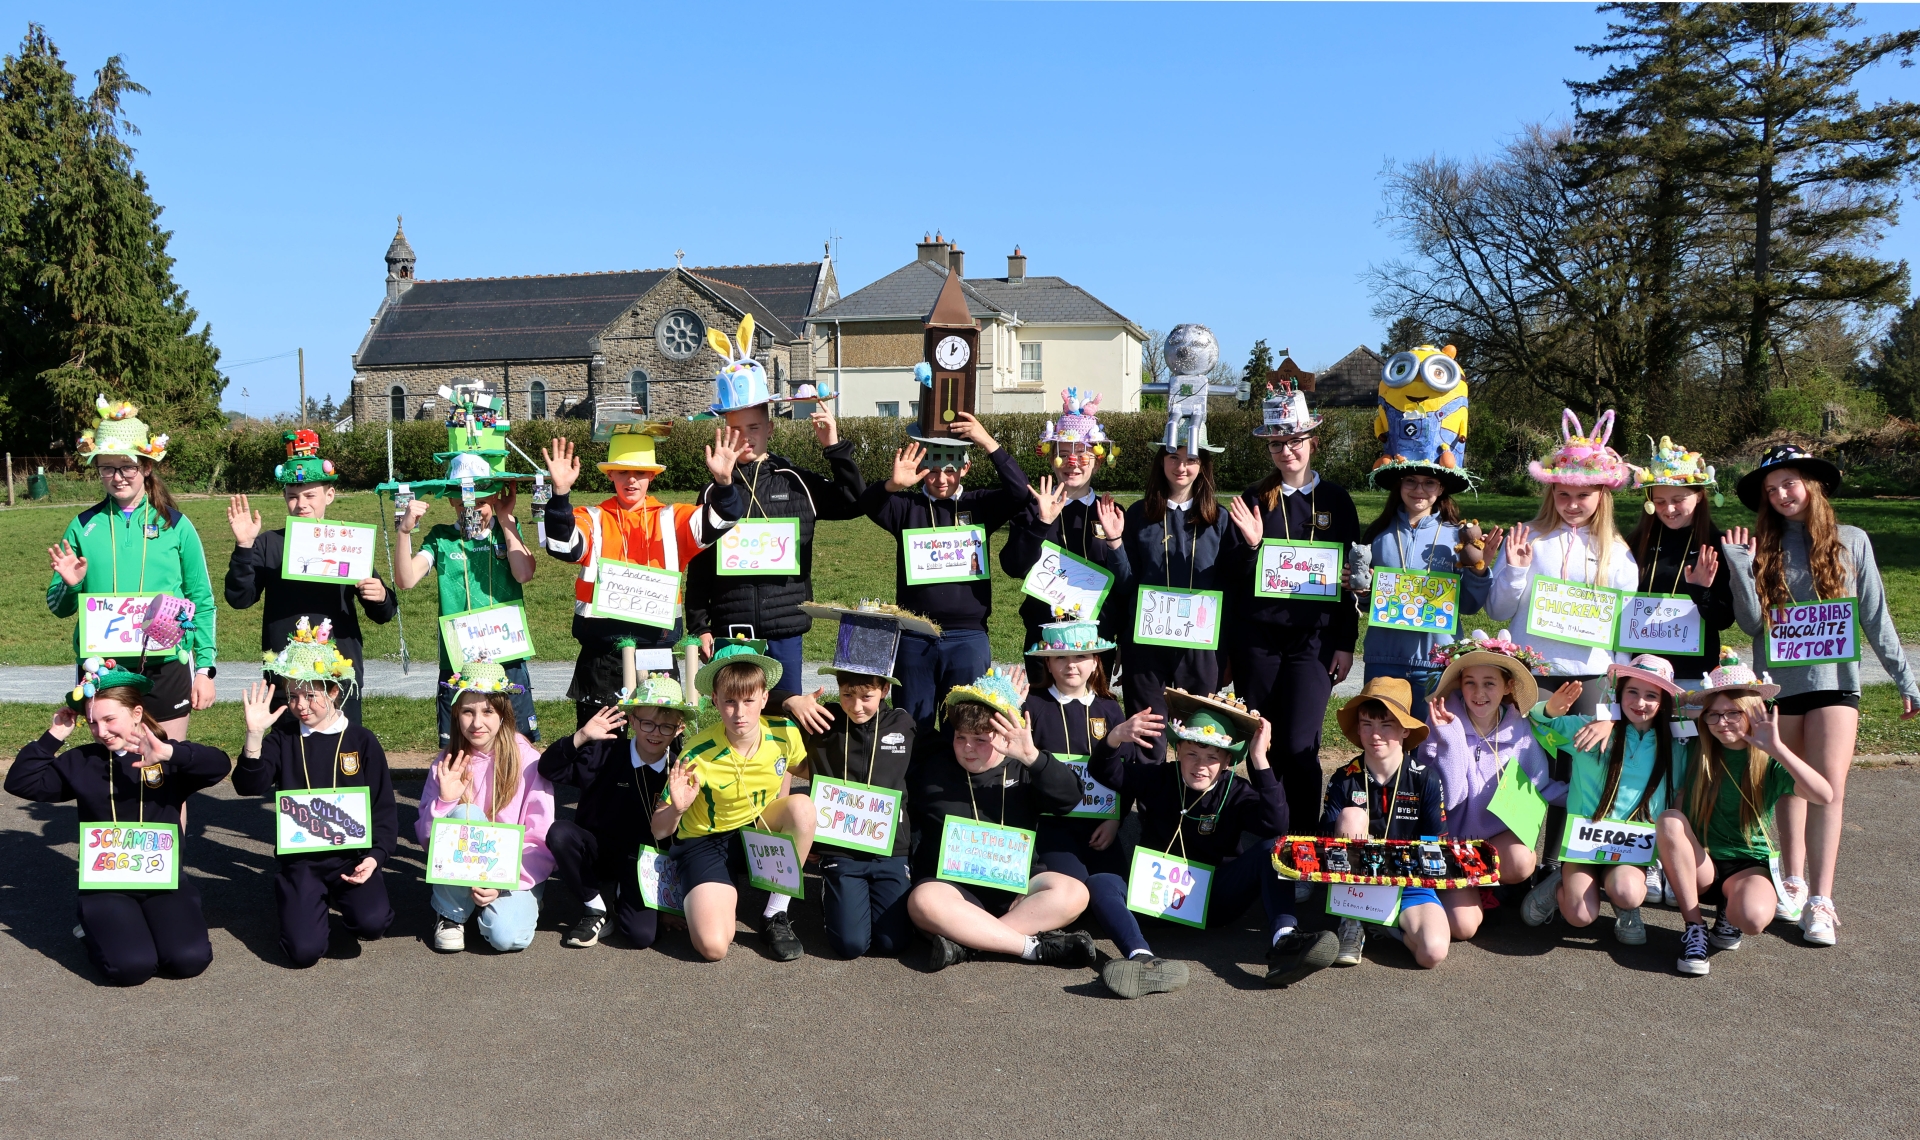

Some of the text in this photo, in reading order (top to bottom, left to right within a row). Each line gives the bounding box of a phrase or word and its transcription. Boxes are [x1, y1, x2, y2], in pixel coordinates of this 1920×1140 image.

[313, 525, 335, 538] BIG
[722, 525, 790, 562] Goofey
[726, 554, 760, 568] Gee
[1280, 546, 1325, 572] Easter
[622, 568, 661, 583] Andrew
[1399, 576, 1454, 600] Eggy
[1538, 582, 1616, 604] THE COUNTRY
[96, 598, 114, 611] The
[608, 592, 642, 610] BOB
[1142, 590, 1176, 614] Sir
[1535, 596, 1612, 622] CHICKENS
[1634, 598, 1680, 617] Peter
[468, 623, 510, 640] Hurling
[510, 630, 526, 643] HAT
[1142, 612, 1194, 638] Robot
[1628, 618, 1688, 643] Rabbit!
[1770, 620, 1846, 639] CHOCOLATE
[1777, 637, 1847, 660] FACTORY
[752, 789, 766, 808] 11
[868, 797, 892, 816] HAS
[816, 806, 888, 840] SPRUNG
[88, 828, 174, 852] SCRAMBLED
[460, 824, 484, 848] Big
[951, 828, 978, 843] ALL
[982, 832, 1004, 847] THE
[1578, 826, 1654, 849] HEROE'S
[92, 852, 144, 872] EGGS
[452, 850, 498, 872] Bunny
[946, 858, 961, 870] IN
[964, 860, 986, 876] THE
[1152, 862, 1192, 886] 200
[1334, 896, 1340, 906] by
[1342, 900, 1364, 910] Eamonn
